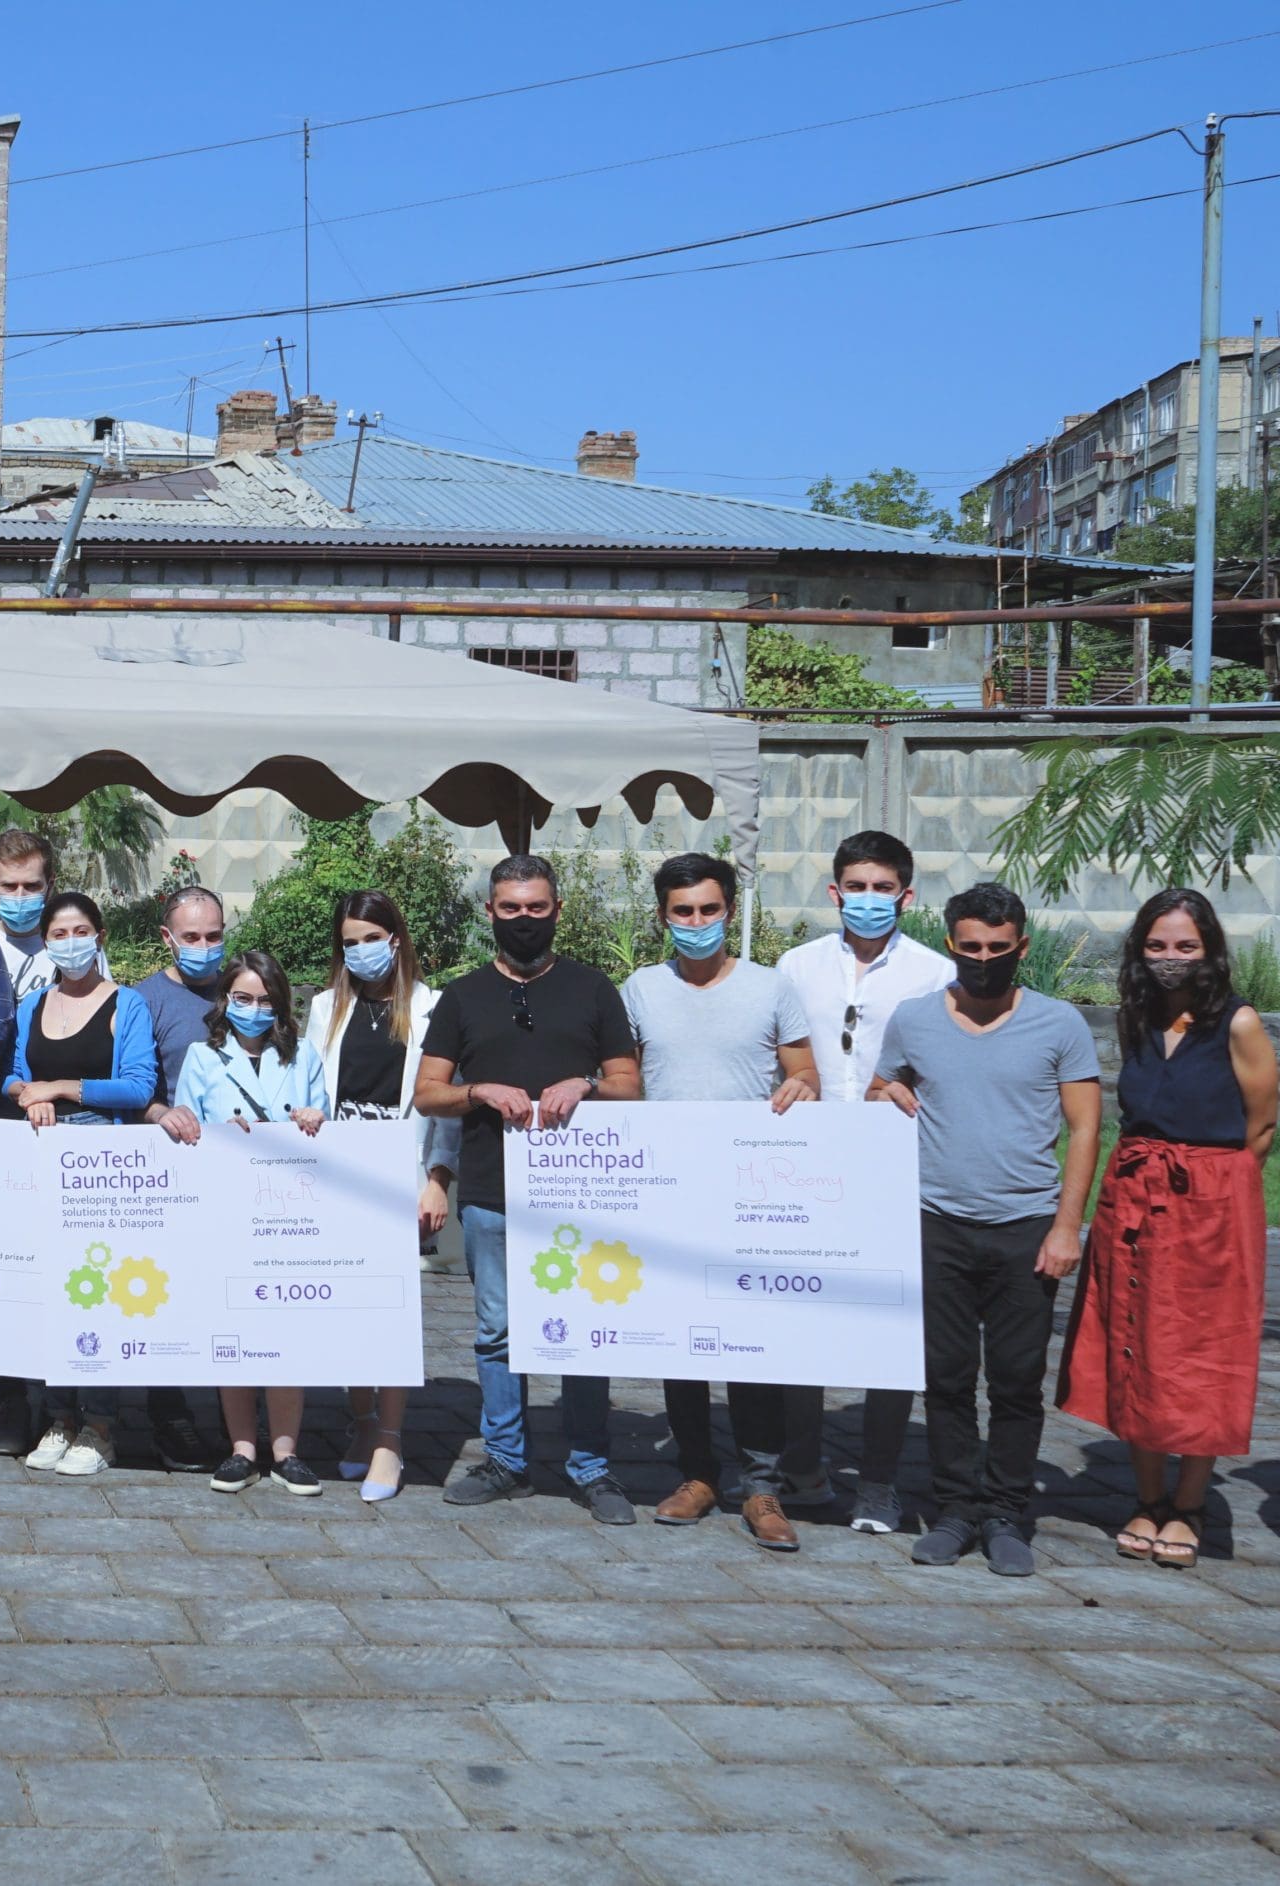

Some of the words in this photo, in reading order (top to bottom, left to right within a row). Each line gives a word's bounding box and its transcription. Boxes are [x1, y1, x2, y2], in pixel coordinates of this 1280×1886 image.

[527, 1127, 619, 1146] GovTech
[734, 1139, 807, 1148] Congratulations
[61, 1149, 146, 1168] GovTech
[250, 1157, 317, 1166] Congratulations
[528, 1149, 644, 1173] Launchpad
[62, 1170, 168, 1193] Launchpad
[528, 1174, 587, 1186] Developing
[620, 1175, 677, 1187] generation
[528, 1187, 576, 1196] solutions
[580, 1189, 591, 1197] to
[595, 1189, 638, 1197] connect
[62, 1196, 116, 1206] Developing
[145, 1194, 199, 1206] generation
[62, 1207, 107, 1216] solutions
[110, 1208, 120, 1216] to
[528, 1200, 573, 1209] Armenia
[578, 1200, 586, 1209] &
[591, 1200, 638, 1212] Diaspora
[751, 1203, 785, 1212] winning
[788, 1203, 803, 1211] the
[62, 1220, 104, 1228] Armenia
[108, 1219, 116, 1228] &
[120, 1219, 164, 1229] Diaspora
[267, 1218, 298, 1226] winning
[735, 1214, 764, 1222] JURY
[767, 1215, 809, 1223] AWARD
[253, 1228, 278, 1236] JURY
[281, 1228, 320, 1236] AWARD
[5, 1253, 24, 1261] prize
[737, 1274, 751, 1290] €
[759, 1275, 822, 1293] 1,000
[255, 1285, 268, 1300] €
[275, 1284, 331, 1302] 1,000
[591, 1328, 617, 1348] giz
[121, 1339, 147, 1359] giz
[693, 1342, 716, 1350] HUB
[722, 1343, 764, 1353] Yerevan
[242, 1350, 280, 1358] Yerevan
